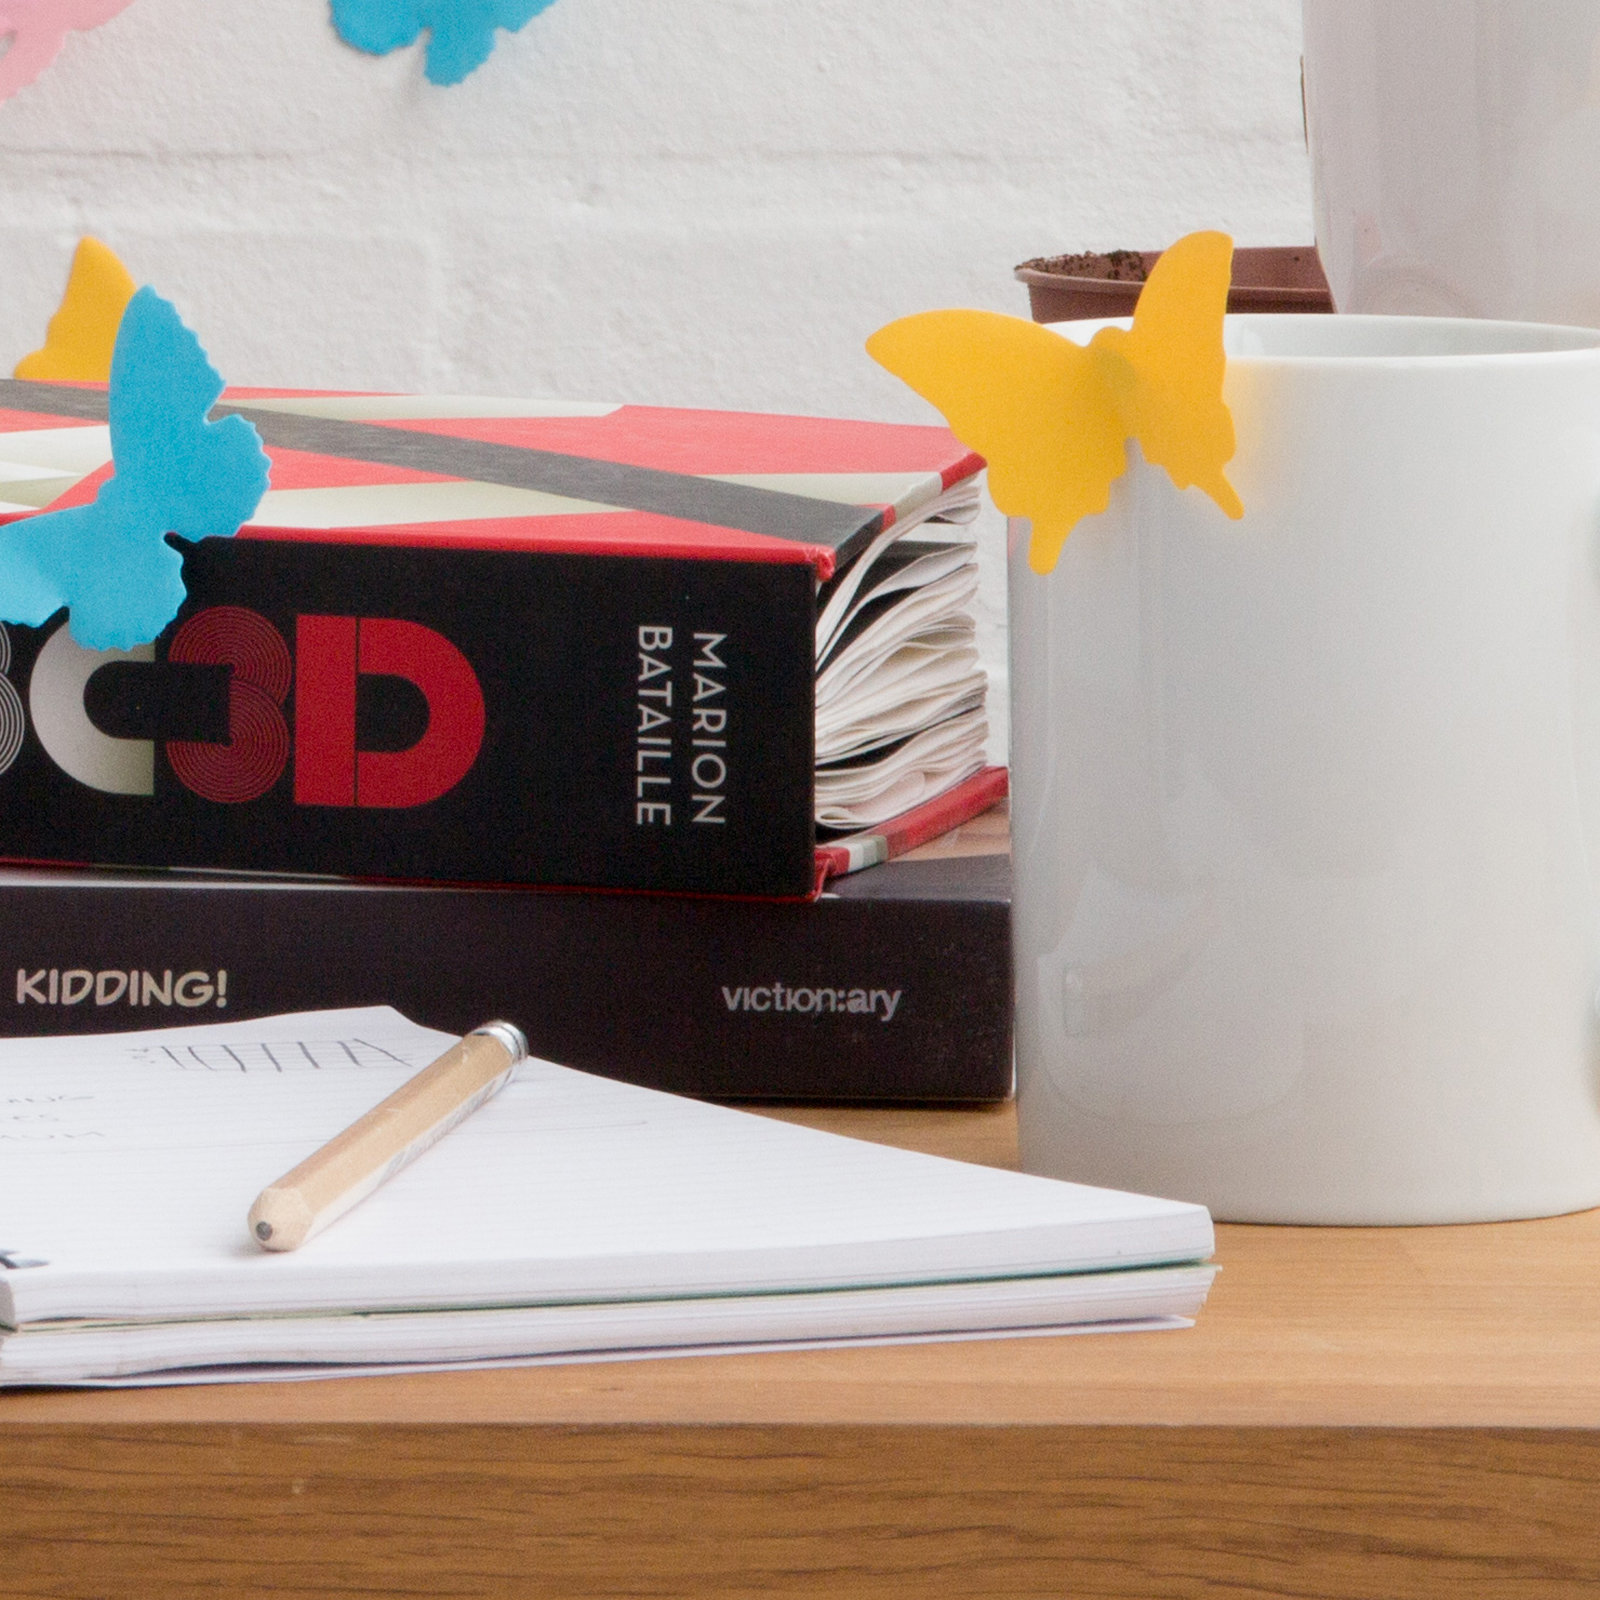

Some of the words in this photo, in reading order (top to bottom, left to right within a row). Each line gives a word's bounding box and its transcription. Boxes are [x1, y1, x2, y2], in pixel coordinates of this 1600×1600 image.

[637, 625, 673, 826] BATAILLE
[692, 631, 727, 824] MARION
[16, 968, 227, 1008] KIDDING!
